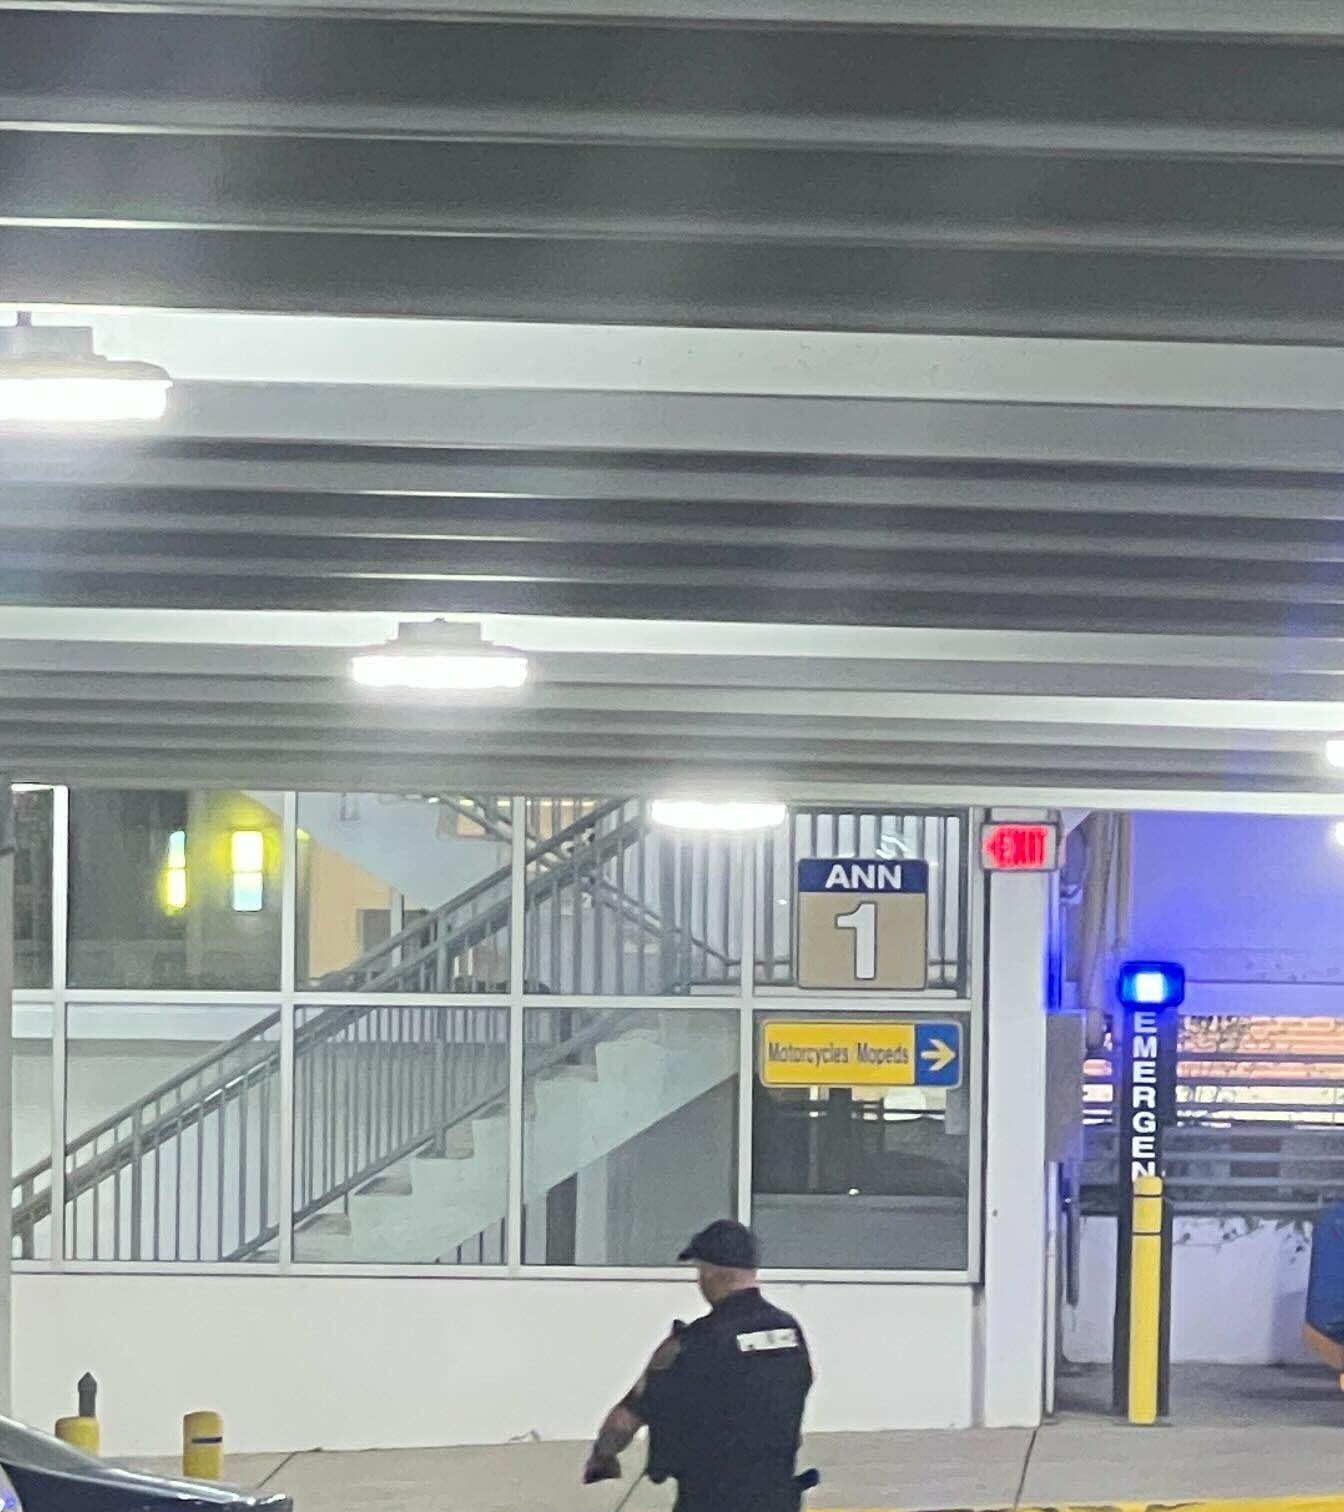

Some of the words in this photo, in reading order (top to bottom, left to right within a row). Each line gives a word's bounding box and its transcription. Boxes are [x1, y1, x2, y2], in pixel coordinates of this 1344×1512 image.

[999, 828, 1047, 867] EXIT
[824, 863, 902, 890] ANN
[835, 902, 877, 980] 1
[768, 1042, 849, 1066] Motorcycles
[857, 1042, 909, 1065] Mopeds
